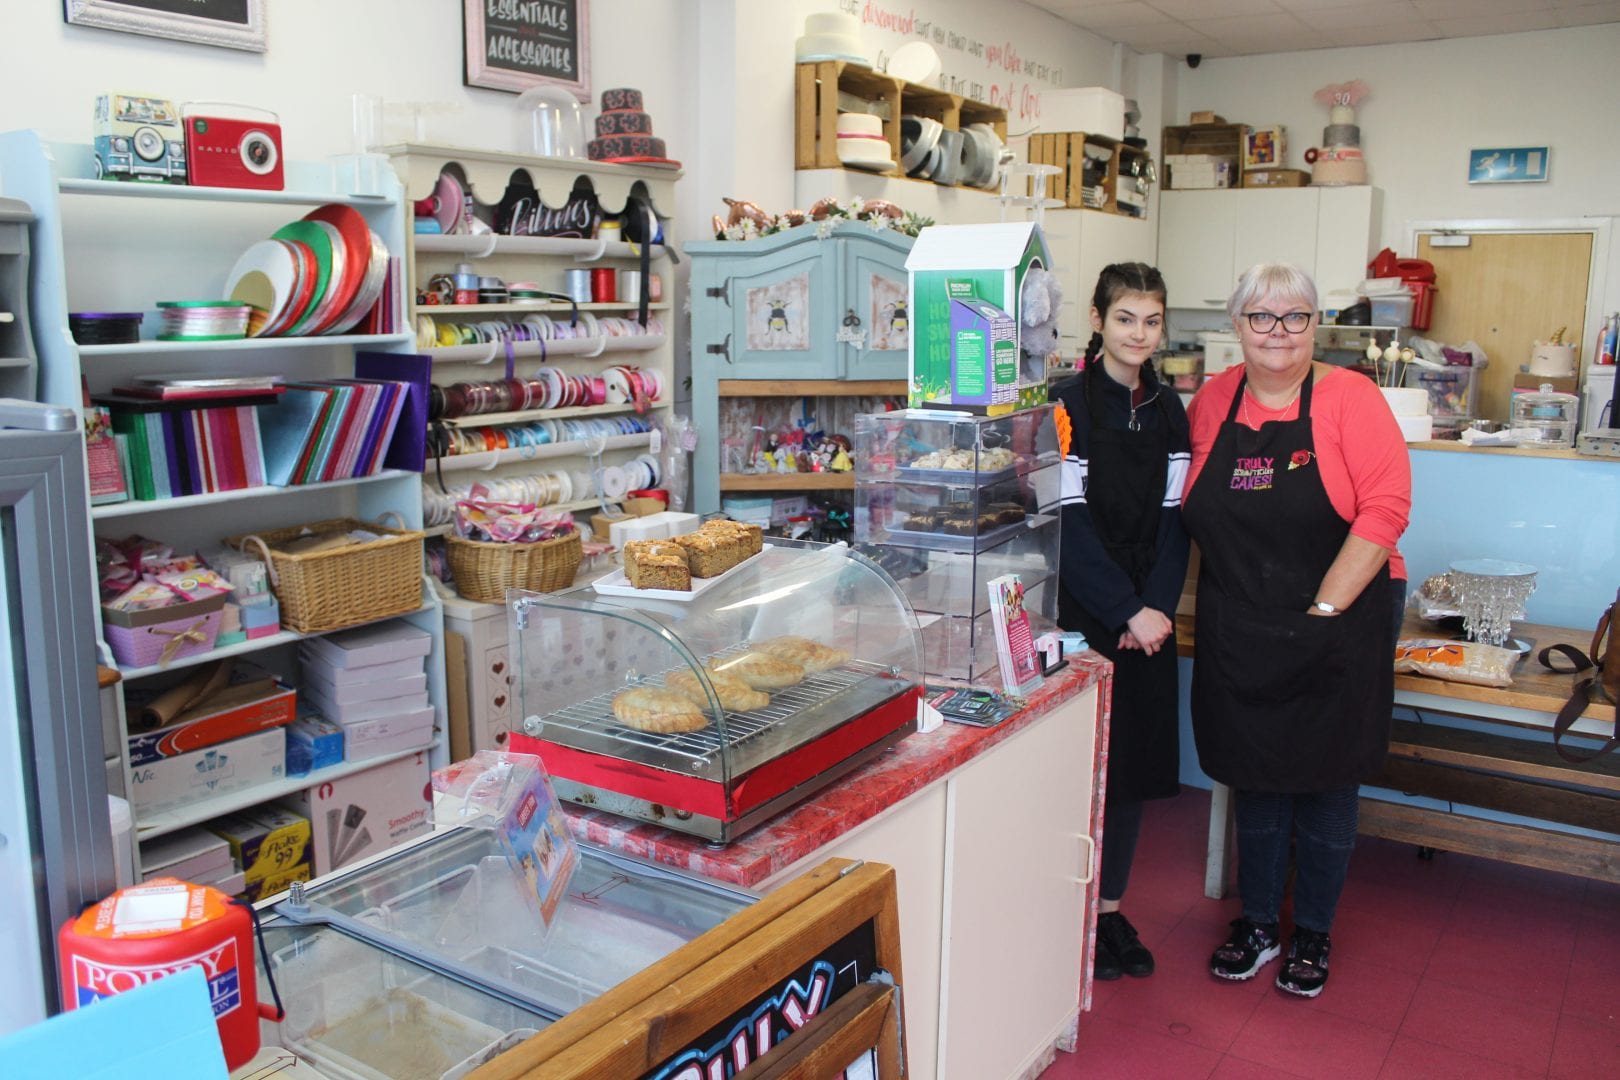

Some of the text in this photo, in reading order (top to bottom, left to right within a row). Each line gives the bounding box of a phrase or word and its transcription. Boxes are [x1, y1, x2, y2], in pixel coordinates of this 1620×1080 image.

[487, 0, 568, 31] ESSENTIALS
[487, 34, 572, 73] ACCESSORIES
[197, 145, 238, 156] RADIO
[1237, 457, 1274, 469] TRULY
[388, 808, 426, 831] Smoothy
[275, 847, 294, 869] 99
[85, 949, 224, 995] POY
